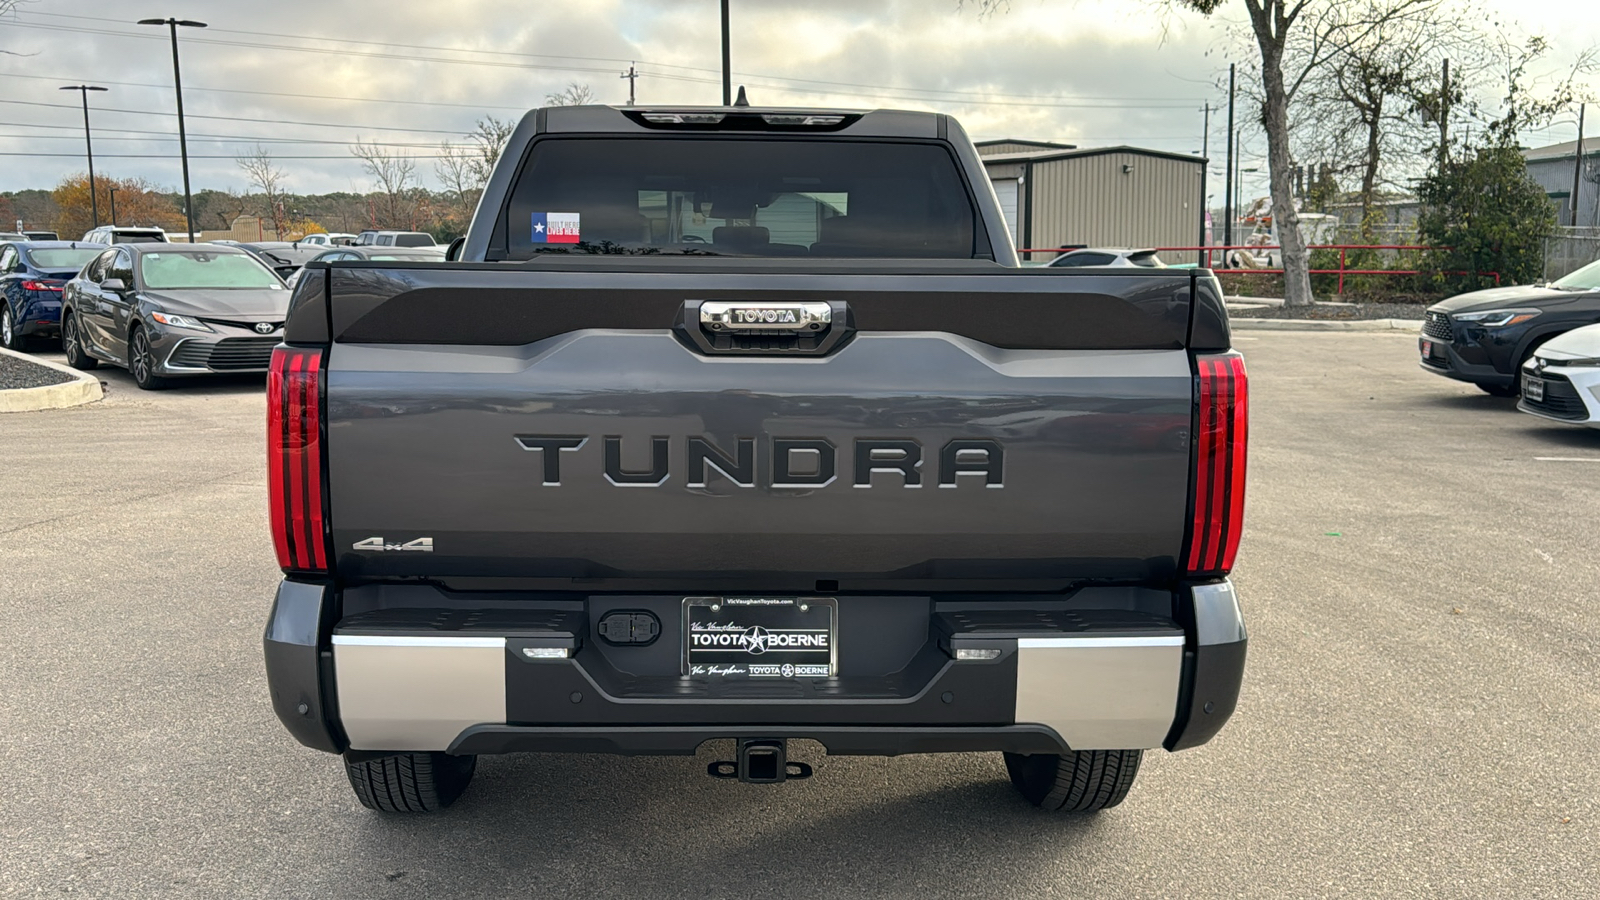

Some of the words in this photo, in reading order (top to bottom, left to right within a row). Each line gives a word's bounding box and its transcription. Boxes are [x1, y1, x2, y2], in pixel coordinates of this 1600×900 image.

[735, 309, 796, 323] TOYOTA
[514, 435, 1005, 489] TUNDRA
[691, 634, 748, 646] TOYOTA
[767, 634, 828, 647] BOERNE
[749, 666, 780, 675] TOYOTA
[794, 666, 828, 675] BOERNE
